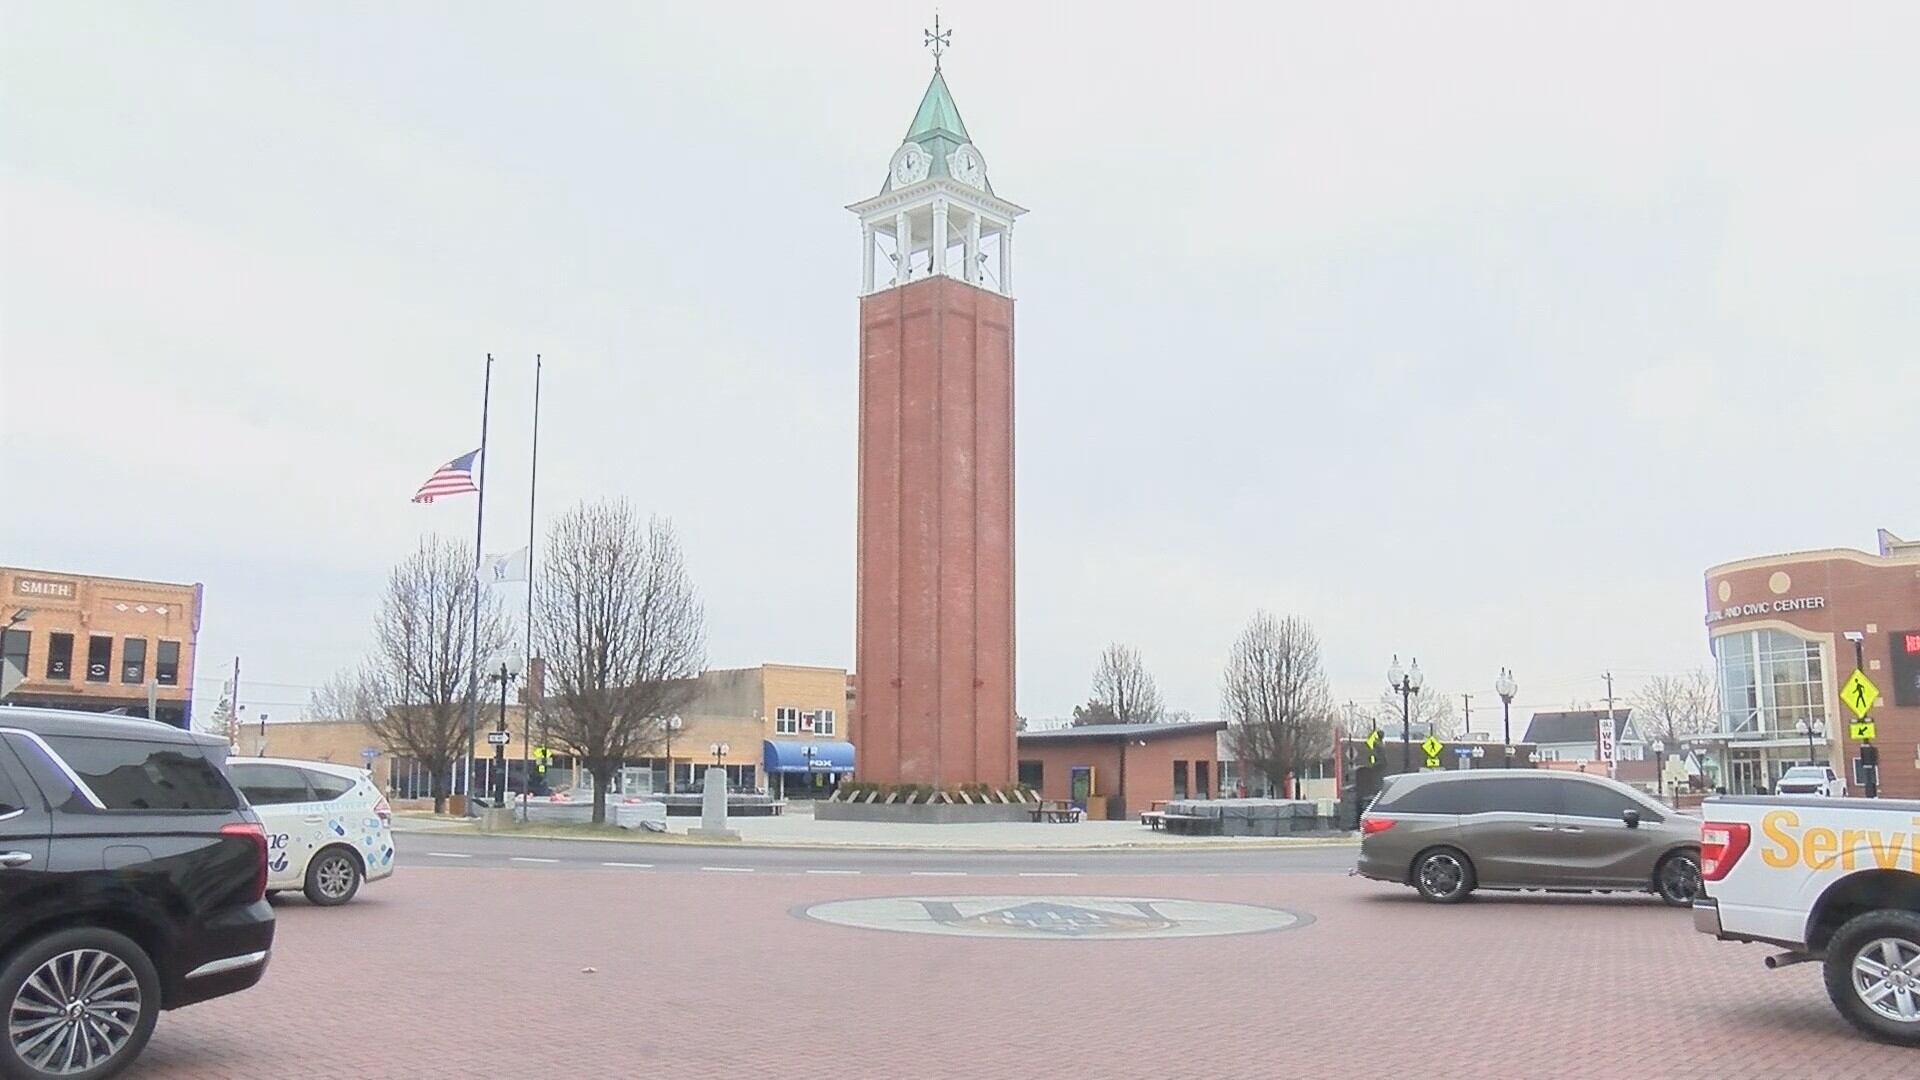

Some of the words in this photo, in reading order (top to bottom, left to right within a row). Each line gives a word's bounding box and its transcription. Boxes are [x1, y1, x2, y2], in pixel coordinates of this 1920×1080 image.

[1743, 602, 1769, 616] CIVIC
[1773, 596, 1824, 612] CENTER
[1761, 809, 1920, 874] Servi
